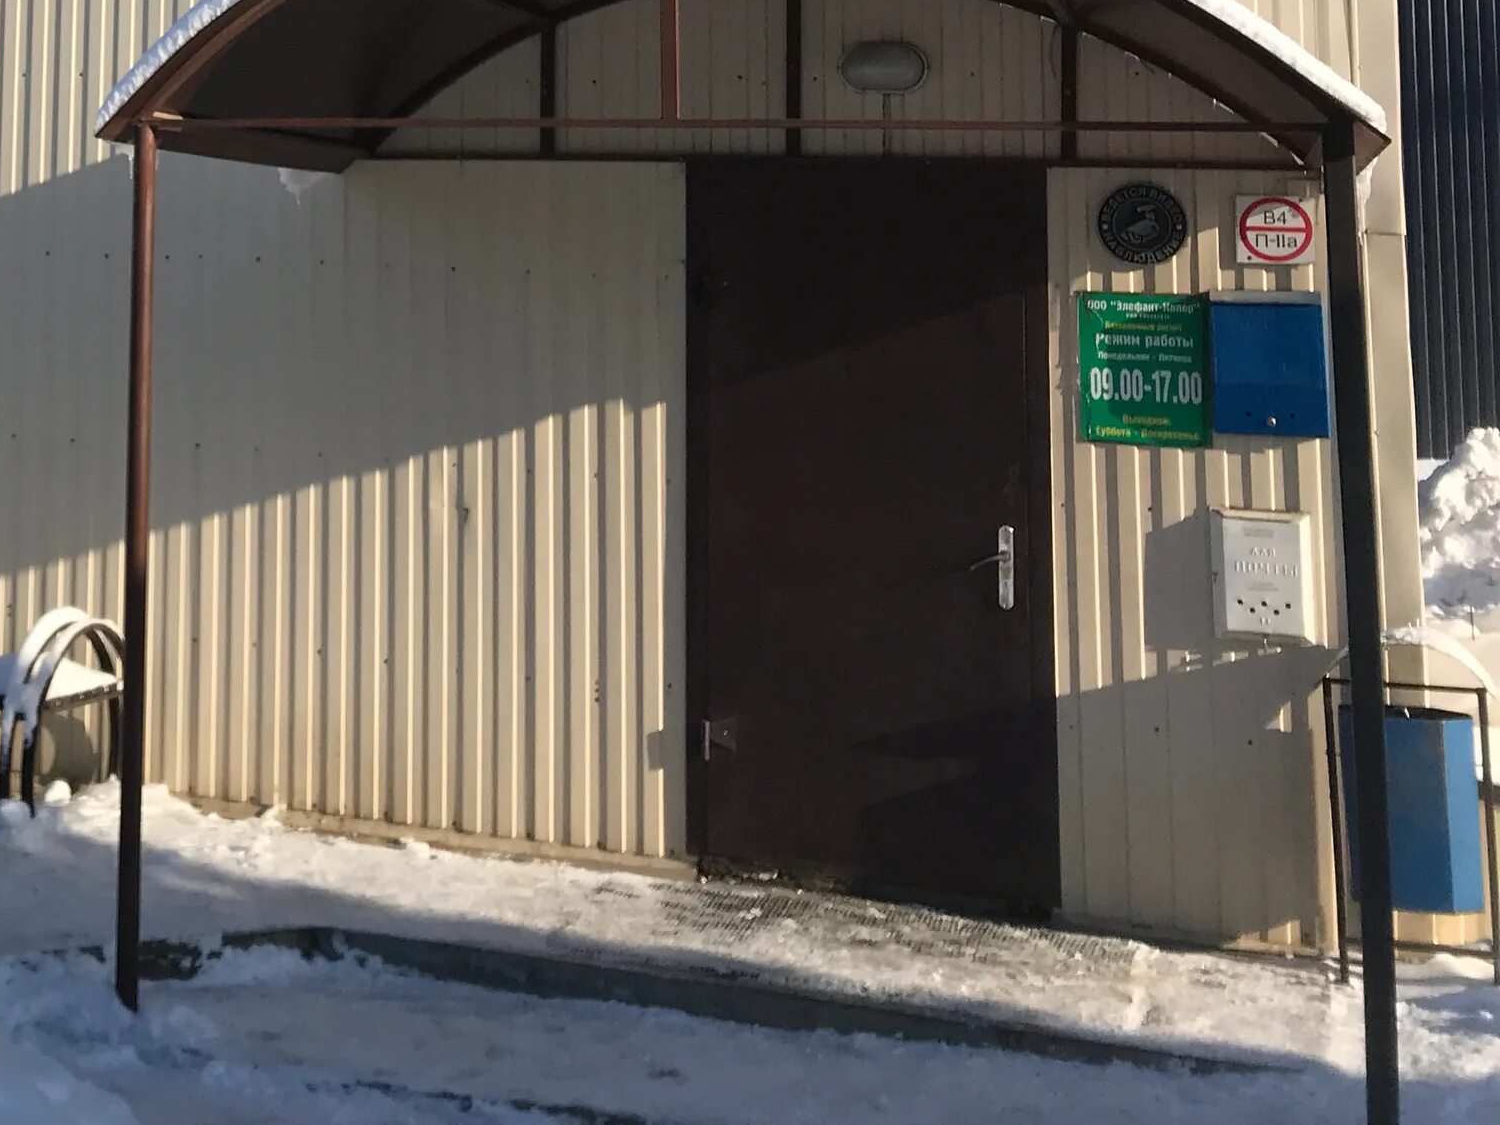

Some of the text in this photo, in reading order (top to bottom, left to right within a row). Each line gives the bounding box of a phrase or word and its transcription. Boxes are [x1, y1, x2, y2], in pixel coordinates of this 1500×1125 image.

[1087, 300, 1107, 311] ООО
[1096, 333, 1194, 349] Режим работы
[1090, 367, 1203, 405] 09.00-17.00
